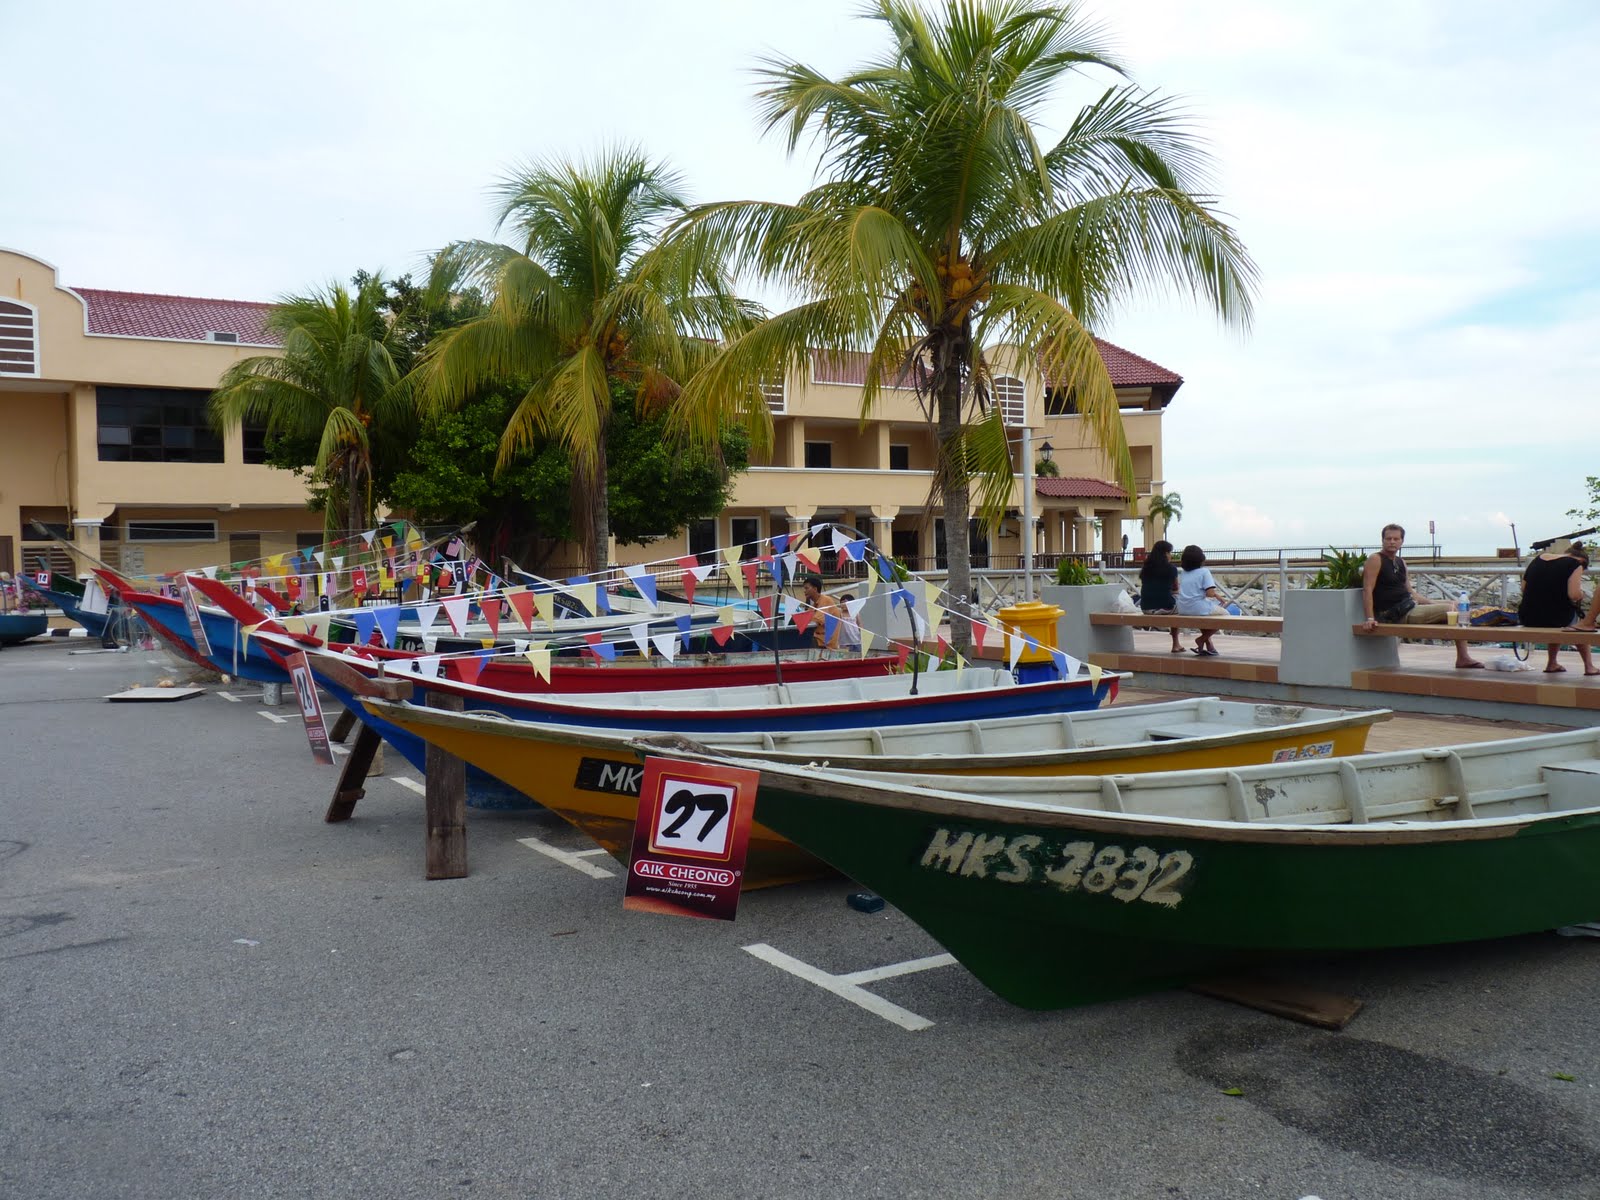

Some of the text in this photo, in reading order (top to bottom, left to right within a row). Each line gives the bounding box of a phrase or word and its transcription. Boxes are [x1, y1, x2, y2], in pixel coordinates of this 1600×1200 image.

[296, 672, 313, 711] 26
[661, 789, 729, 843] 27
[640, 862, 729, 883] AIK CHEONG
[919, 827, 1043, 883] MKS
[645, 886, 717, 902] www.aikcheong.com.my
